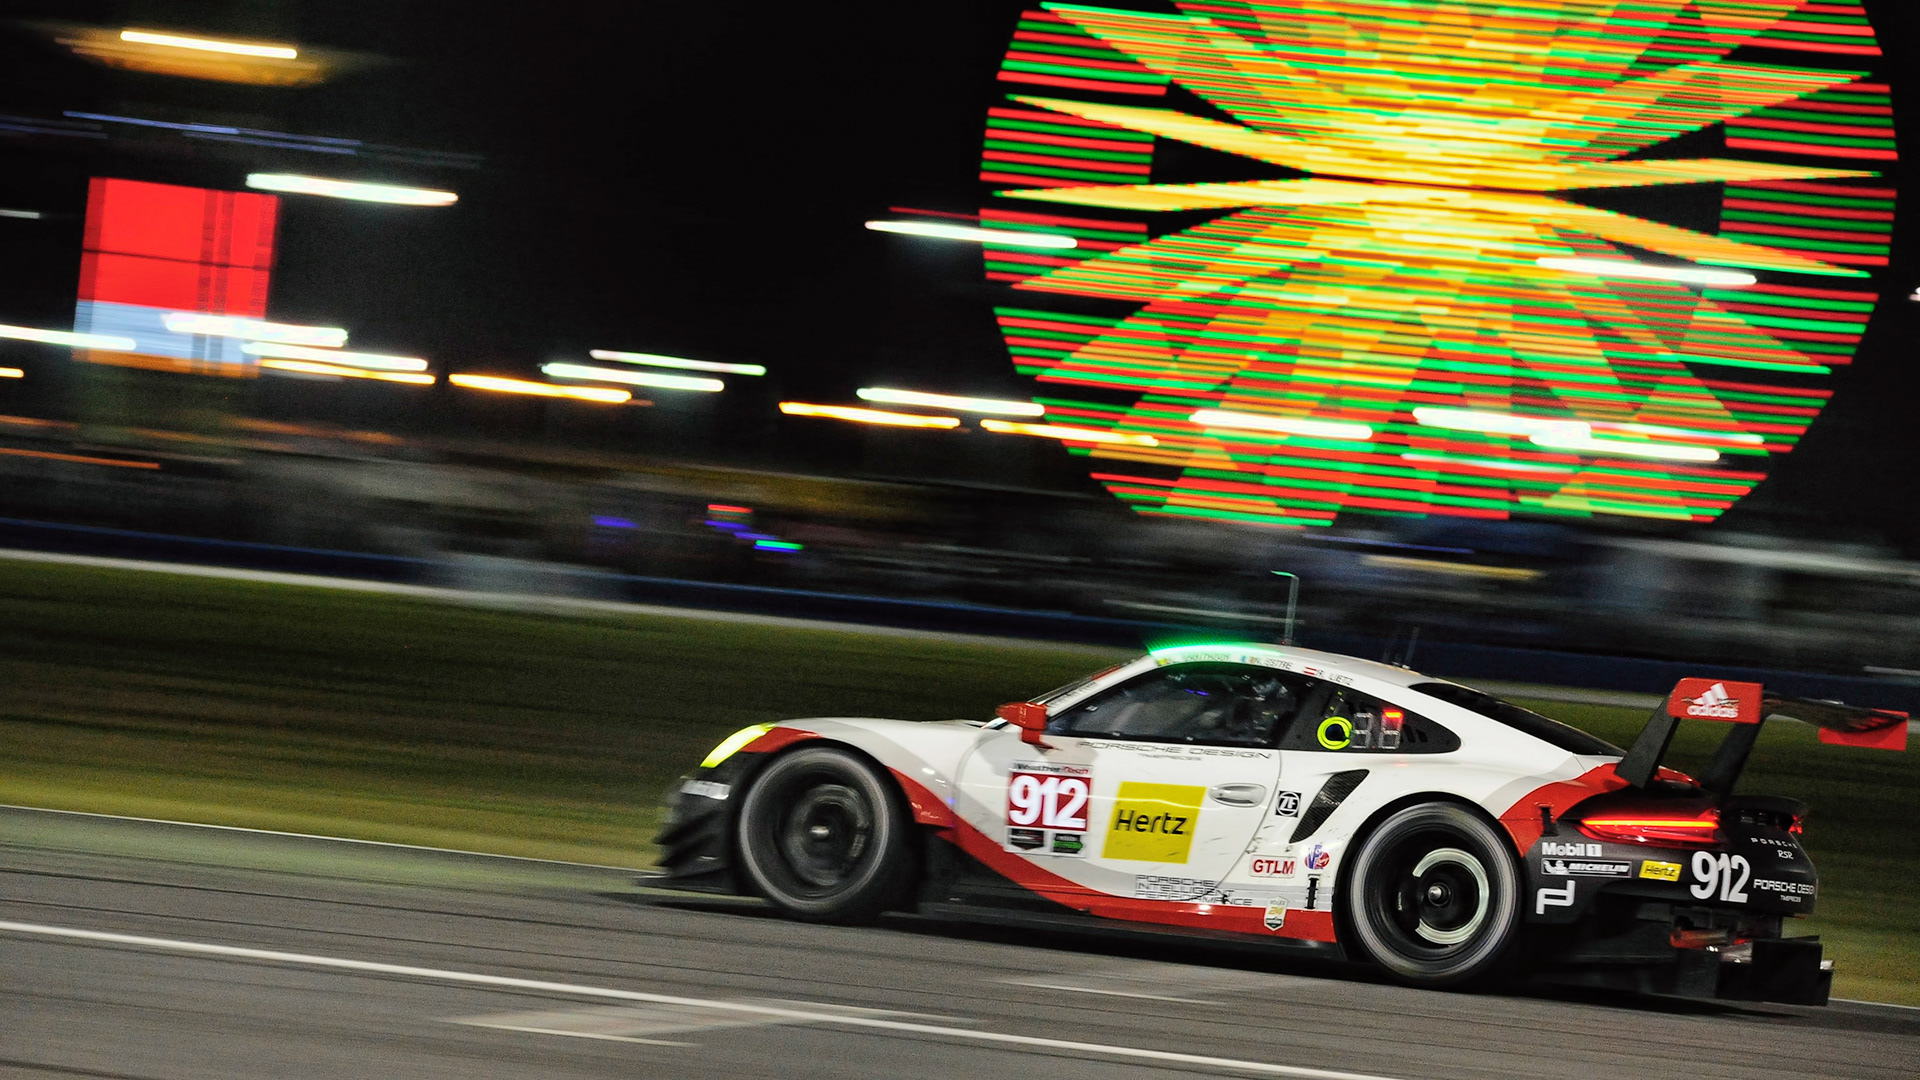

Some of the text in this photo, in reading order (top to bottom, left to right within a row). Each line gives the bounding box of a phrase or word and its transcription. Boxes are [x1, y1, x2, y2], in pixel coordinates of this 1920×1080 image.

[1687, 705, 1738, 718] adidas
[1076, 741, 1272, 759] PORSCHE DESIGN
[1009, 775, 1088, 828] 912
[1115, 809, 1187, 835] Hertz
[1542, 842, 1602, 857] Mobil 1
[1777, 849, 1794, 860] RSR
[1253, 859, 1295, 875] GTLM
[1569, 863, 1630, 873] MICHELIN
[1644, 865, 1677, 877] Hertz
[1135, 875, 1215, 887] PORSCHE
[1690, 850, 1751, 904] 912
[1753, 878, 1797, 894] PORSCHE
